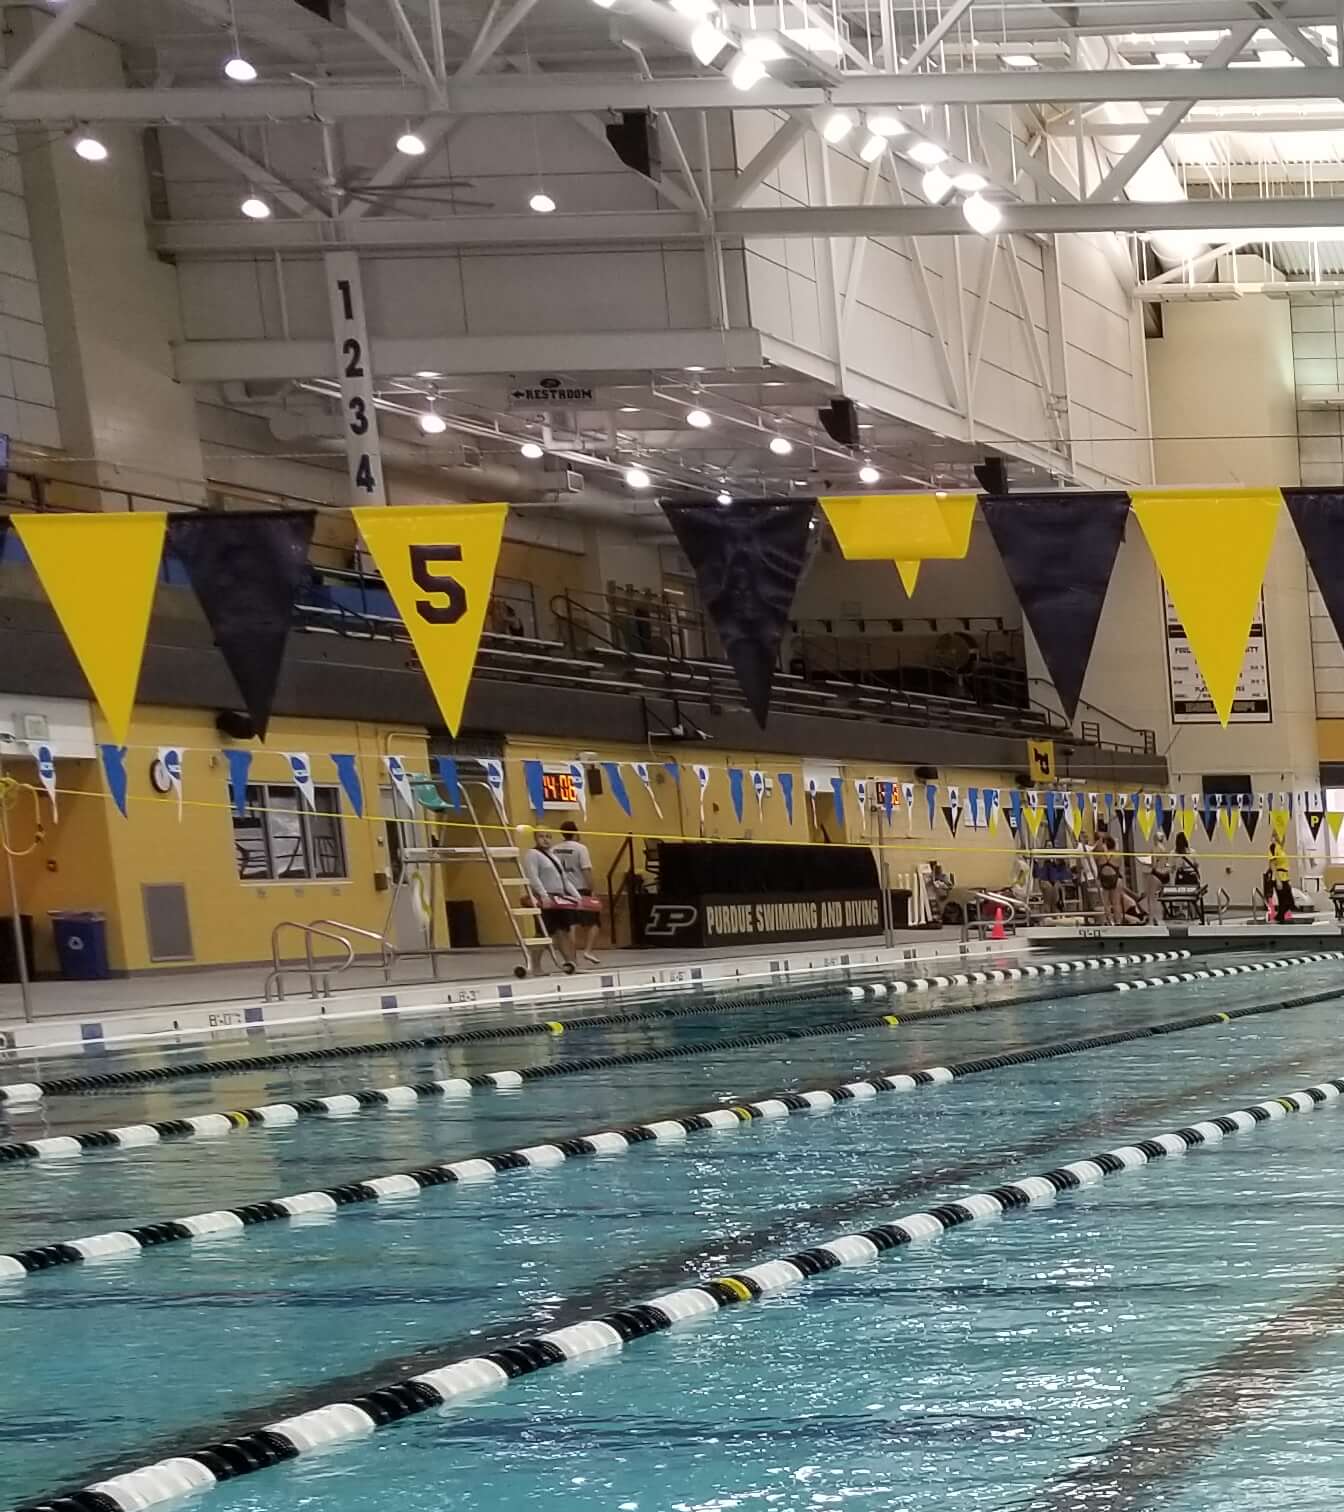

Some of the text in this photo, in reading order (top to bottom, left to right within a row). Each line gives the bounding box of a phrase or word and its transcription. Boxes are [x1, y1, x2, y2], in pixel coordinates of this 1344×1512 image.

[337, 280, 354, 320] 1
[343, 338, 364, 377] 2
[349, 397, 369, 435] 3
[356, 454, 375, 492] 4
[408, 544, 468, 625] 5
[706, 904, 753, 935] PURDUE
[756, 902, 818, 932] SWIMMING
[821, 900, 843, 928] AND
[845, 899, 879, 927] DIVING
